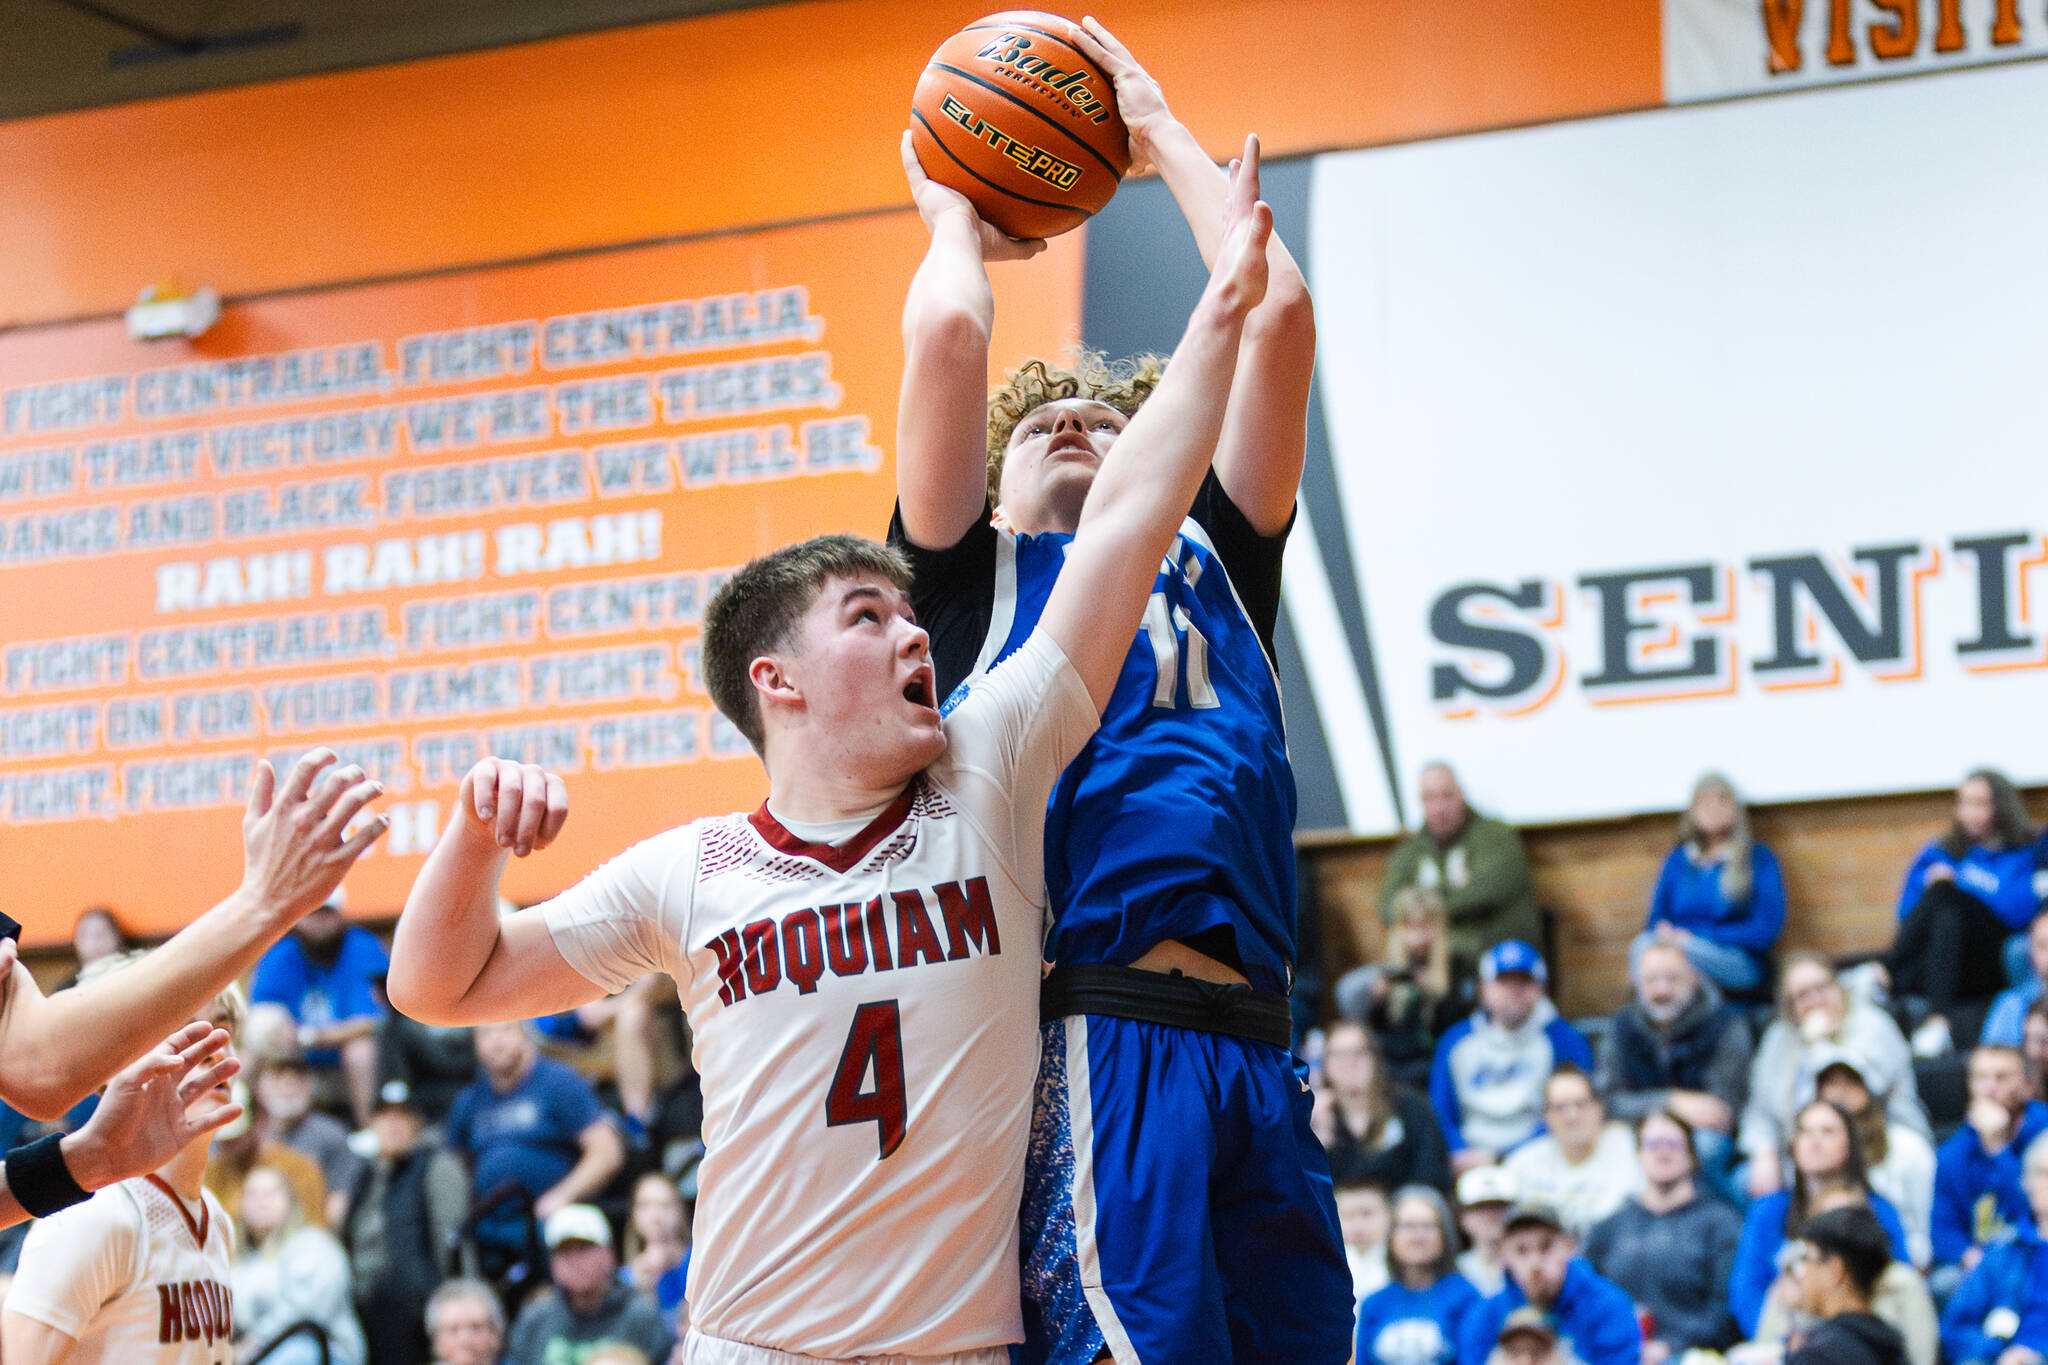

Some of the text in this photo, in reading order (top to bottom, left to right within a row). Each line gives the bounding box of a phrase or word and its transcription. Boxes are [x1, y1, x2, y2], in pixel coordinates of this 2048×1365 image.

[975, 33, 1110, 125] Baden
[994, 66, 1082, 119] PERFECTION
[940, 92, 1083, 191] ELITE PRO
[5, 290, 822, 433] FIGHT CENTRALIA, FIGHT CENTRALIA,
[84, 435, 199, 486] THAT
[208, 408, 398, 474] VICTORY
[403, 389, 549, 451] WE'RE
[558, 377, 652, 433] THE
[658, 355, 841, 420] TIGERS,
[127, 497, 215, 544] AND
[382, 452, 587, 515] FOREVER
[592, 443, 673, 495] WE
[676, 428, 798, 485] WILL
[156, 513, 660, 609] RAH! RAH! RAH!
[5, 637, 129, 692] FIGHT
[138, 611, 396, 679] CENTRALIA,
[404, 592, 539, 647] FIGHT
[105, 700, 165, 746] ON
[170, 689, 256, 739] FOR
[260, 676, 379, 733] YOUR
[415, 732, 480, 785] TO
[486, 721, 580, 772] WIN
[589, 711, 699, 767] THIS
[705, 876, 1001, 1007] HOQUIAM
[826, 999, 907, 1161] 4
